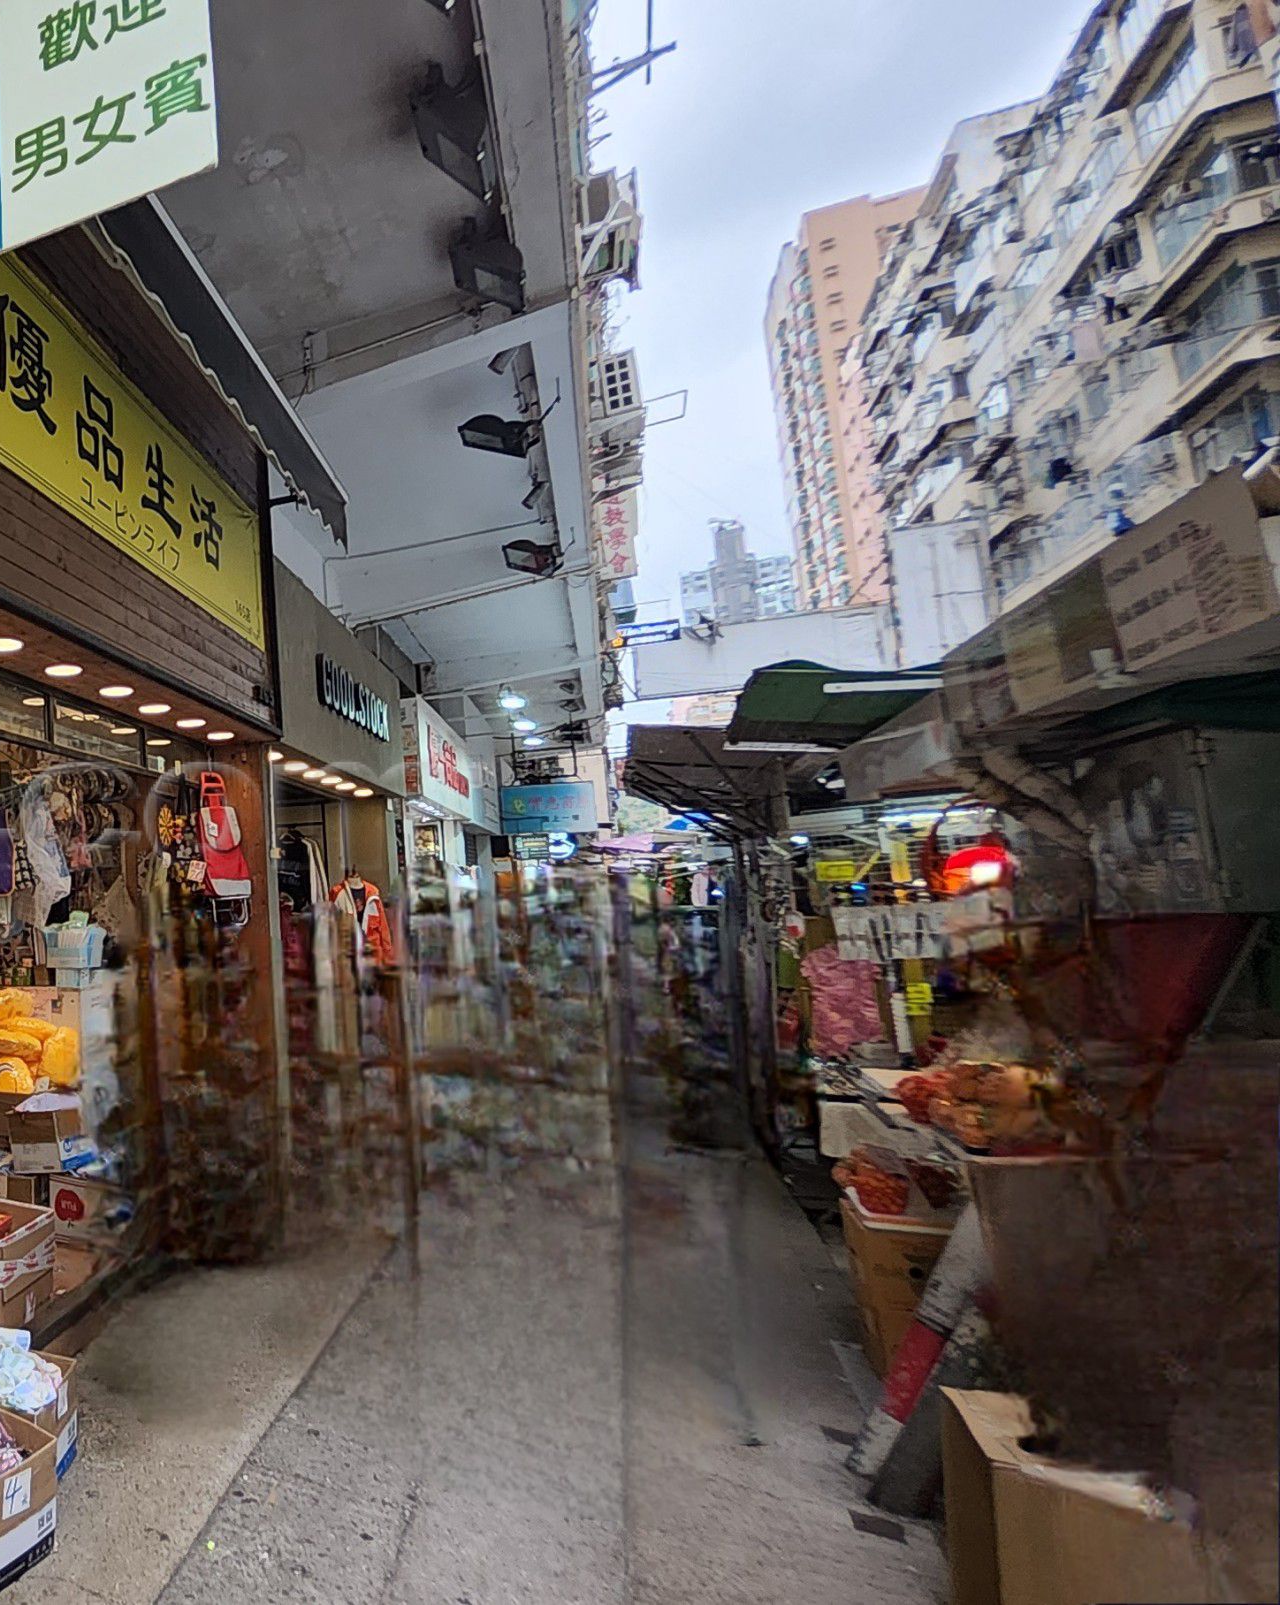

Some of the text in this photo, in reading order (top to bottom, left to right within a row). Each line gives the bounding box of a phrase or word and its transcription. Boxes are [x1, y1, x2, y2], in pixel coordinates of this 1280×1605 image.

[37, 0, 166, 71] 歡迎
[11, 53, 211, 193] 男女賓
